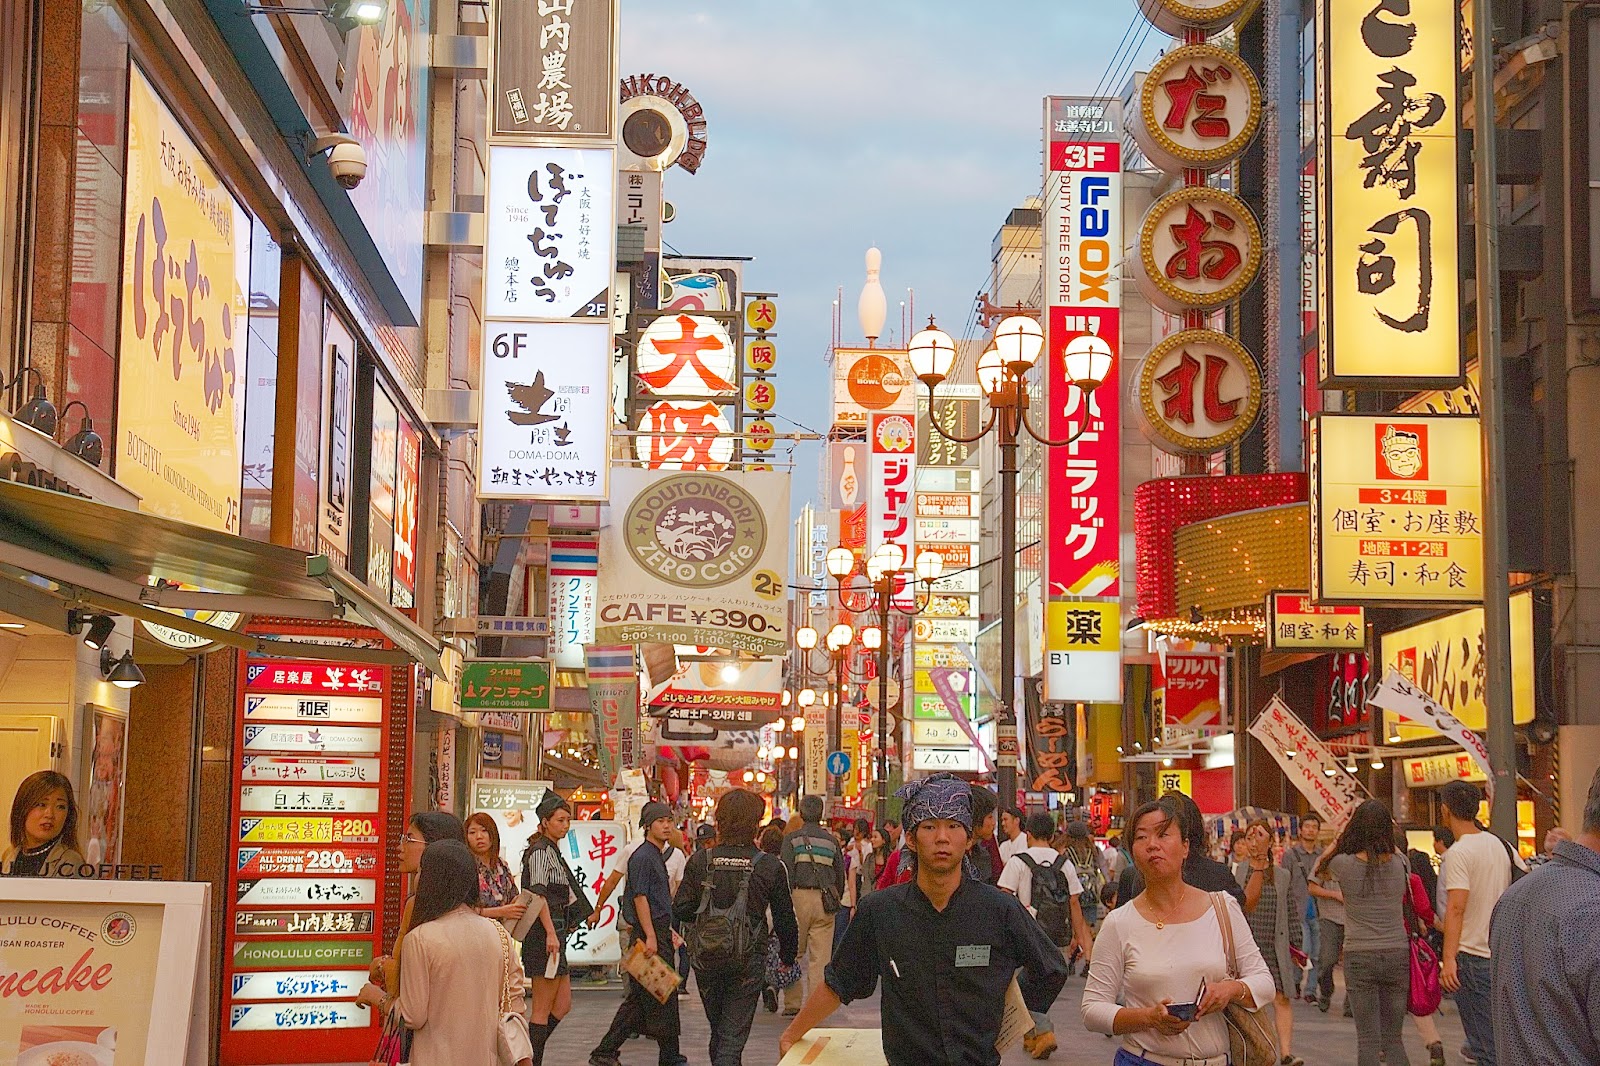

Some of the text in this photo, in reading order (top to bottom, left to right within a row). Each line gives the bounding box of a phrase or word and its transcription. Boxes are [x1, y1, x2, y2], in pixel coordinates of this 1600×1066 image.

[1055, 120, 1116, 133] 法善寺ビル
[1064, 145, 1106, 169] 3F
[579, 186, 592, 210] 大阪
[505, 204, 529, 214] Since
[508, 214, 529, 223] 1946
[1059, 176, 1071, 303] DUTY FREE STORE
[1079, 176, 1111, 303] Laox
[1160, 64, 1244, 426] だおれ
[586, 302, 607, 316] 2F
[492, 332, 528, 359] 6F
[127, 430, 162, 475] BOTEJYU
[509, 450, 580, 461] DOMA-DOMA
[490, 465, 598, 487] 朝までやってます
[635, 482, 755, 524] DOUTONBORI
[225, 496, 239, 533] 2F
[1332, 507, 1481, 536] 個室・お座敷
[923, 530, 967, 539] レインボー
[636, 543, 753, 581] ZERO Cafe
[754, 572, 783, 597] 2F
[1347, 560, 1468, 590] 寿司・和食
[568, 578, 582, 644] クンテープ
[600, 603, 687, 624] CAFE
[1066, 609, 1102, 645] 薬
[1277, 621, 1360, 642] 個室・和食
[1051, 654, 1071, 665] B1
[1167, 659, 1218, 675] ツルハ
[1167, 678, 1209, 690] ドラッグ
[299, 701, 329, 716] 和民
[924, 754, 959, 764] ZAZA
[274, 789, 335, 806] 白木屋
[259, 855, 275, 864] ALL
[276, 856, 304, 864] DRINK
[58, 862, 163, 881] COFFEE
[239, 882, 251, 892] 2F
[40, 916, 98, 943] COFFEE
[237, 914, 253, 924] 2F
[287, 912, 355, 932] 山内農場
[24, 940, 65, 949] ROASTER
[243, 948, 363, 959] HONOLULU COFFEE
[276, 976, 348, 996] びっくりドンキー
[275, 1007, 347, 1028] びっくりドンキー
